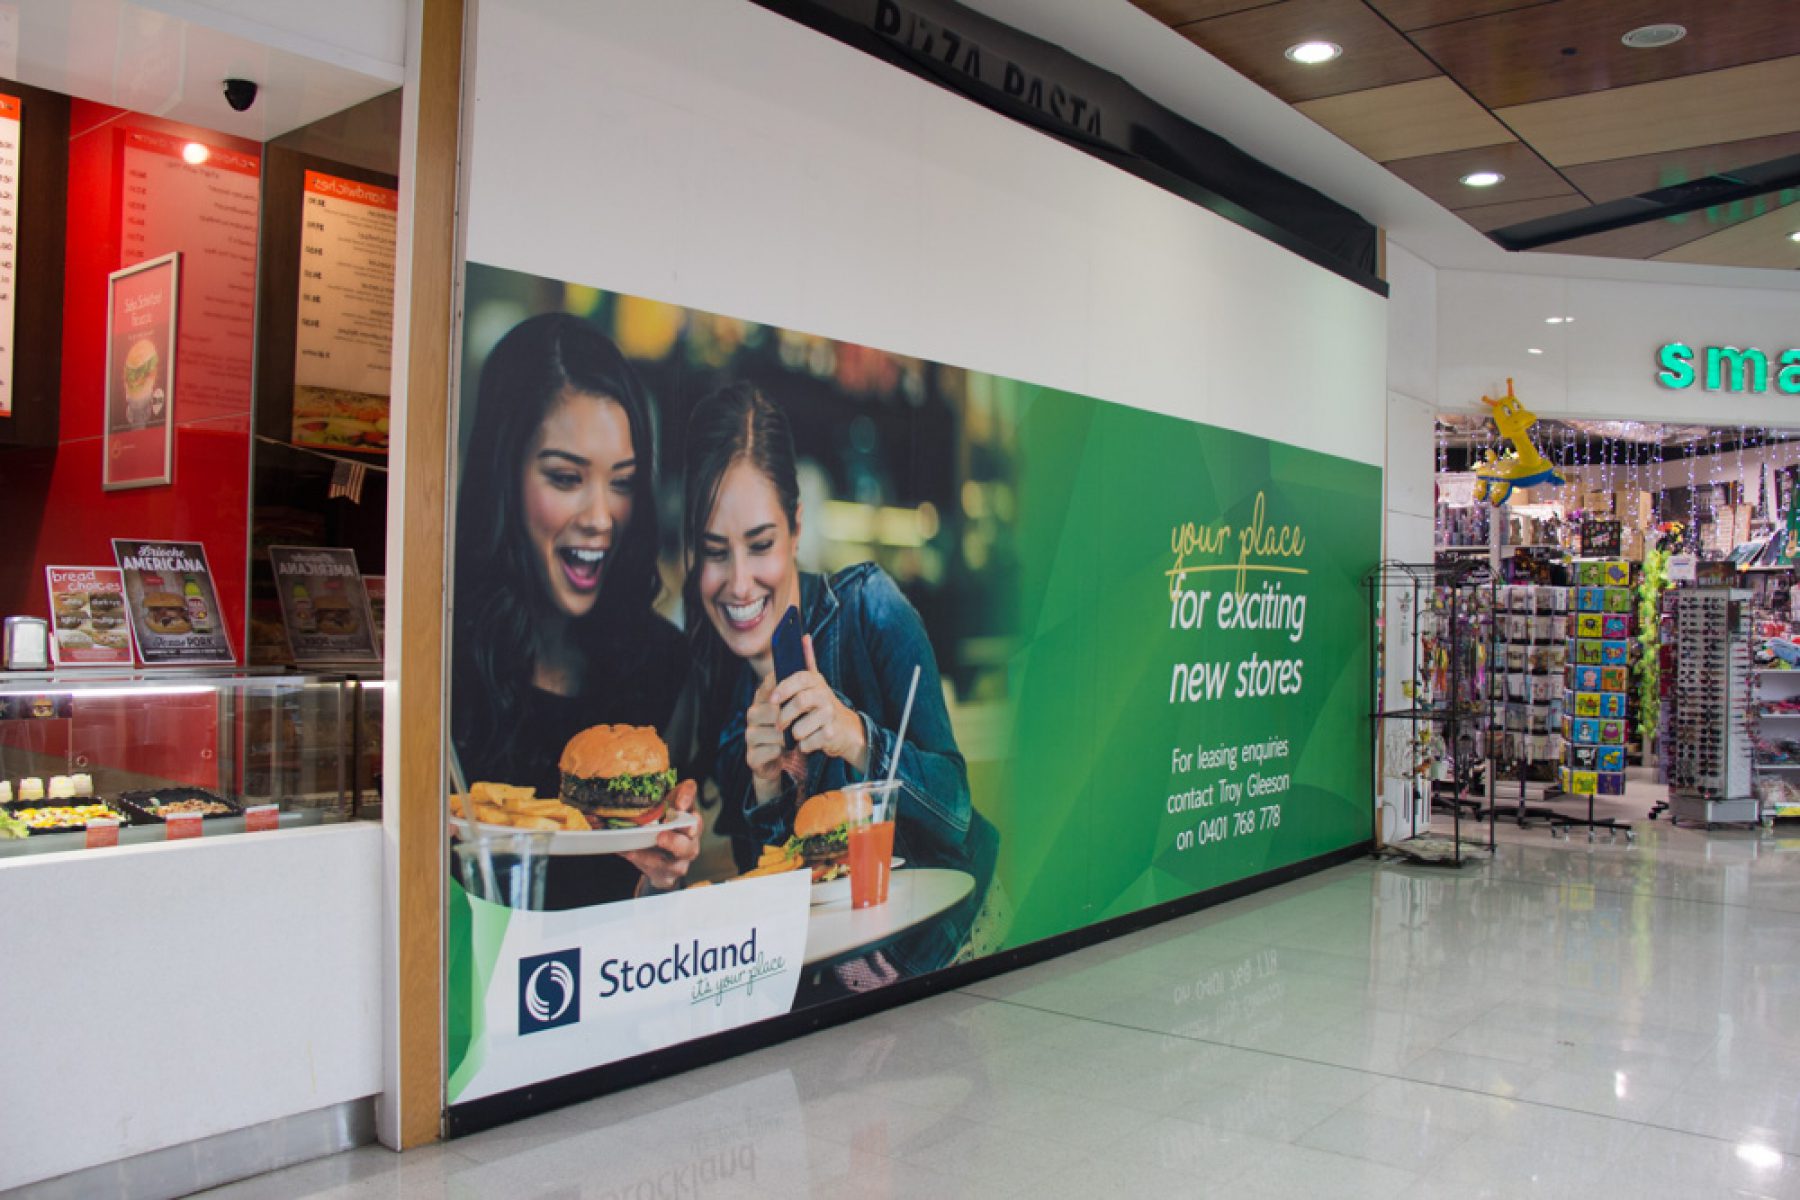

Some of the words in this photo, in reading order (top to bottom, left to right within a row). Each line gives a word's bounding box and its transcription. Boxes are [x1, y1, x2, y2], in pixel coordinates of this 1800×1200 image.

[123, 556, 207, 573] AMERICANA
[1170, 522, 1231, 602] your
[1236, 491, 1306, 603] place
[52, 570, 96, 582] bread
[1170, 572, 1212, 629] for
[1217, 580, 1306, 642] exciting
[1170, 661, 1231, 704] new
[1235, 651, 1304, 698] stores
[1172, 748, 1193, 774] For
[1197, 743, 1238, 770] leasing
[1242, 736, 1289, 766] enquiries
[1167, 784, 1214, 814] contact
[1218, 778, 1243, 806] Troy
[1247, 772, 1290, 798] Gleeson
[1177, 830, 1194, 851] on
[1198, 816, 1227, 845] 0401
[1233, 809, 1255, 837] 768
[1260, 804, 1281, 831] 778
[599, 928, 757, 998] Stockland
[715, 970, 745, 1007] your
[747, 951, 785, 996] place
